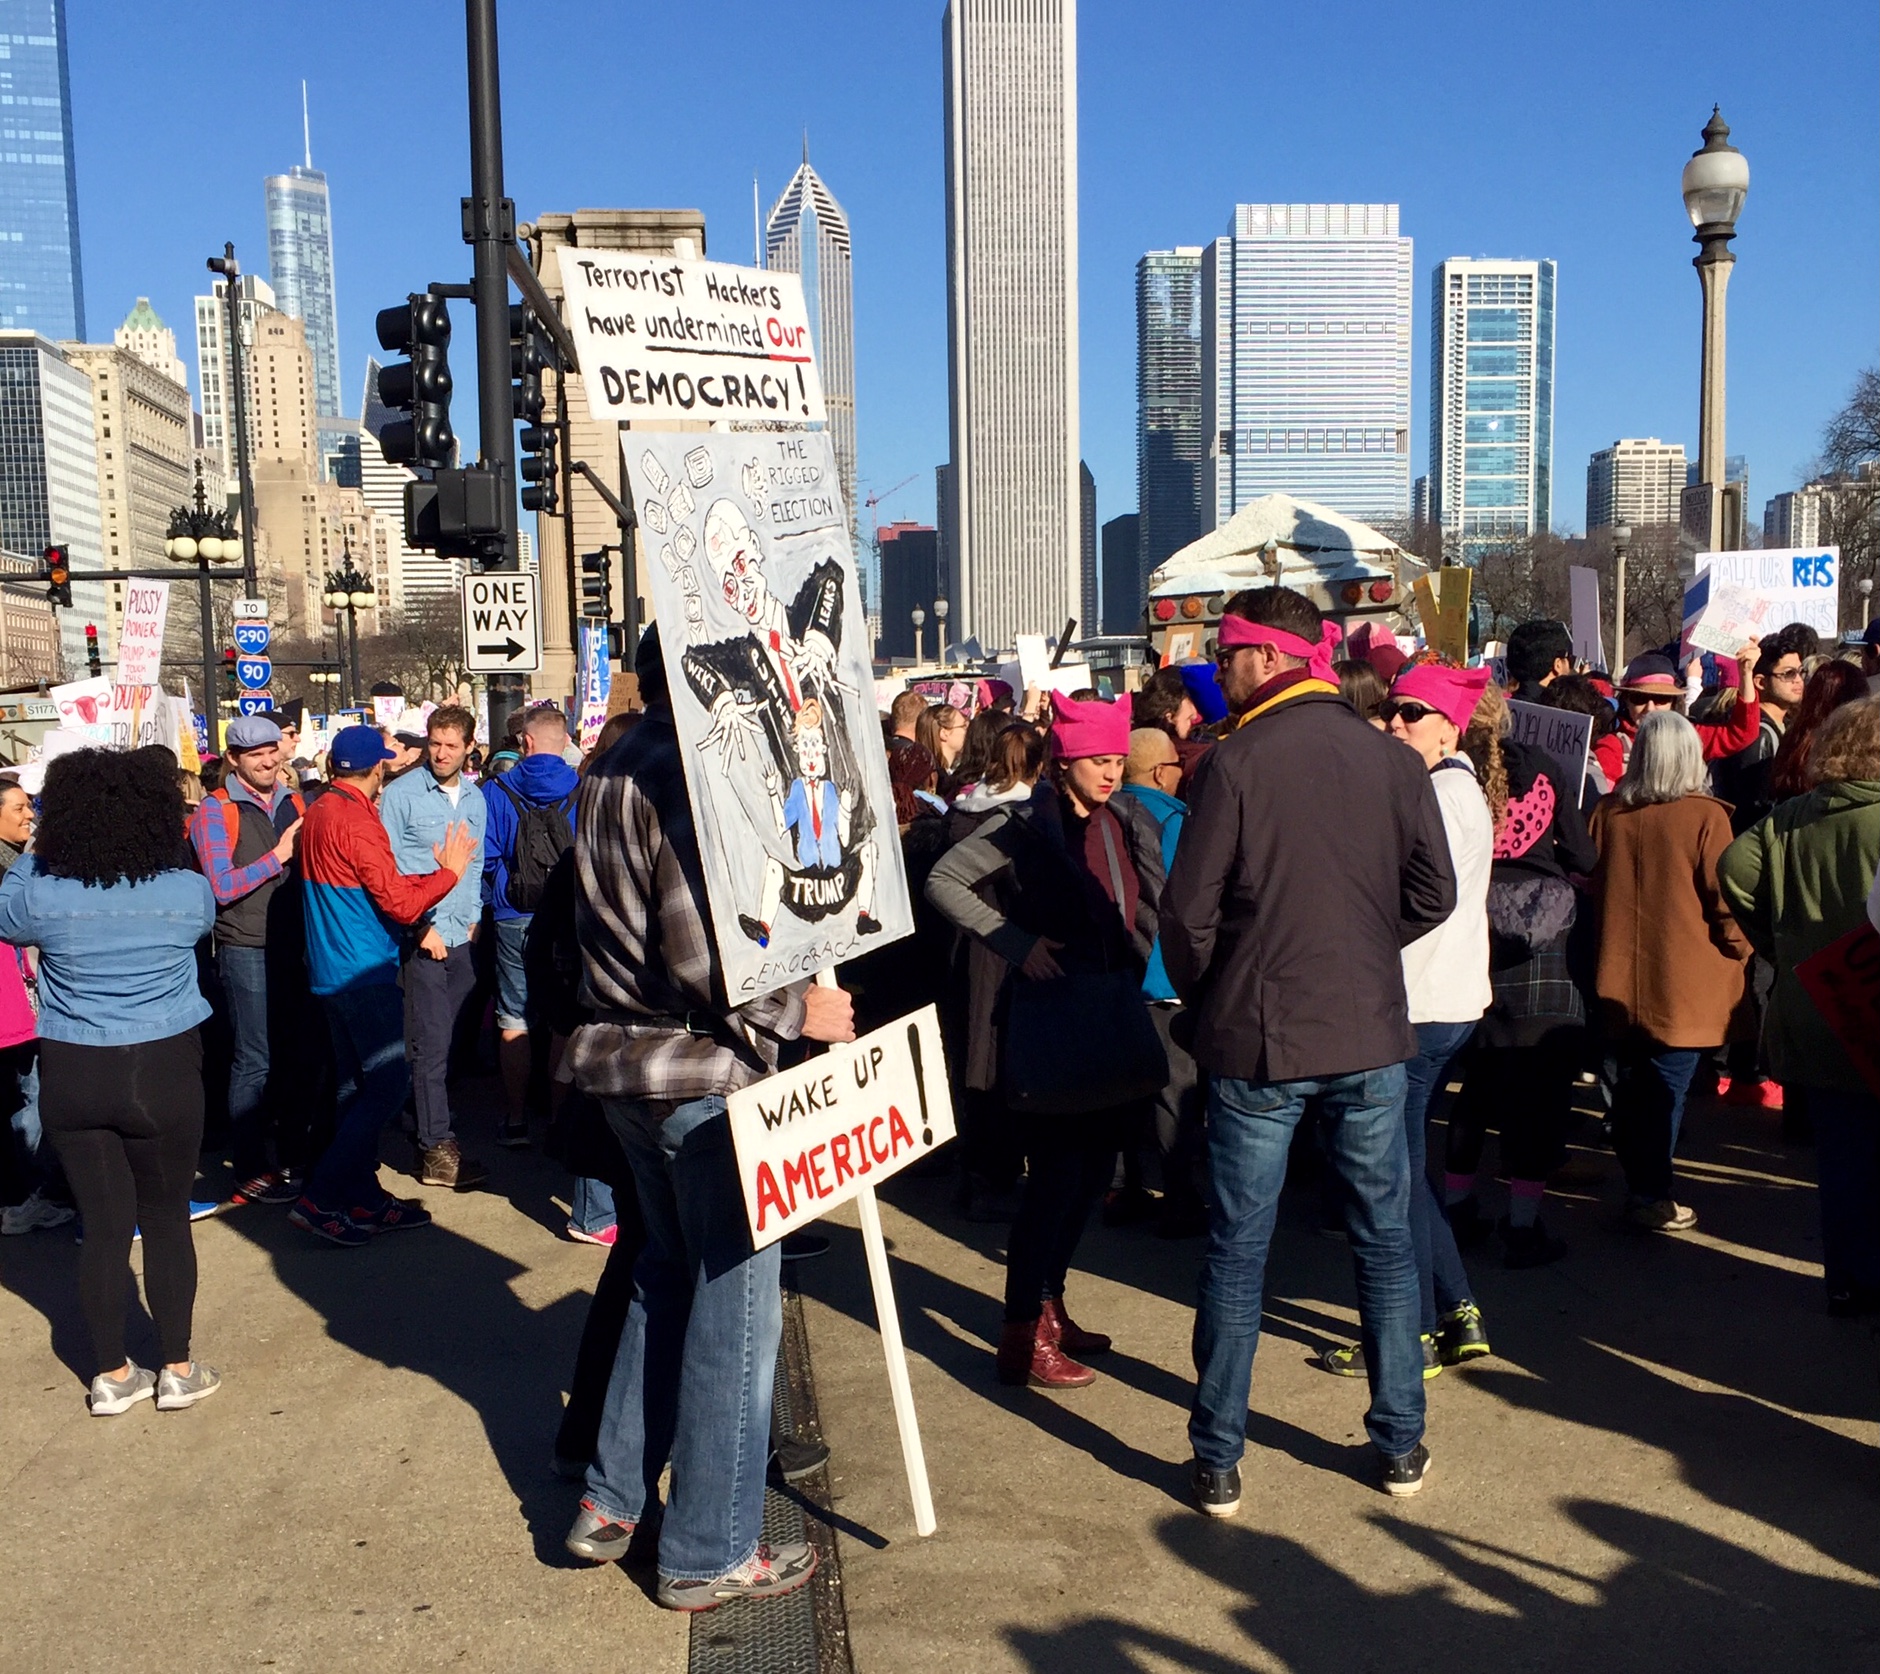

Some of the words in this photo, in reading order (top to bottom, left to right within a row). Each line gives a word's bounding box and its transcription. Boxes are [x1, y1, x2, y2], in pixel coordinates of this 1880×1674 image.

[577, 260, 684, 297] Terrorist
[705, 273, 782, 310] Hackers
[585, 306, 637, 337] have
[645, 306, 765, 349] undermined
[766, 317, 806, 348] Our
[600, 363, 810, 416] DEMOCRACY!
[776, 440, 807, 460] THE
[769, 466, 821, 486] RIGGED
[771, 496, 834, 524] ELECTION
[1792, 554, 1835, 587] REPS
[129, 589, 162, 615] PUSSY
[473, 582, 527, 605] ONE
[818, 577, 838, 628] LEAKS
[244, 604, 258, 613] TO
[473, 609, 529, 632] WAY
[238, 629, 267, 644] 290
[125, 674, 143, 684] THIS
[242, 665, 264, 680] 90
[687, 659, 717, 695] WIKI
[245, 701, 266, 716] 94
[790, 872, 845, 906] TRUMP
[741, 936, 860, 990] DEMOCRACY
[757, 1074, 838, 1131] WAKE
[854, 1046, 884, 1089] UP
